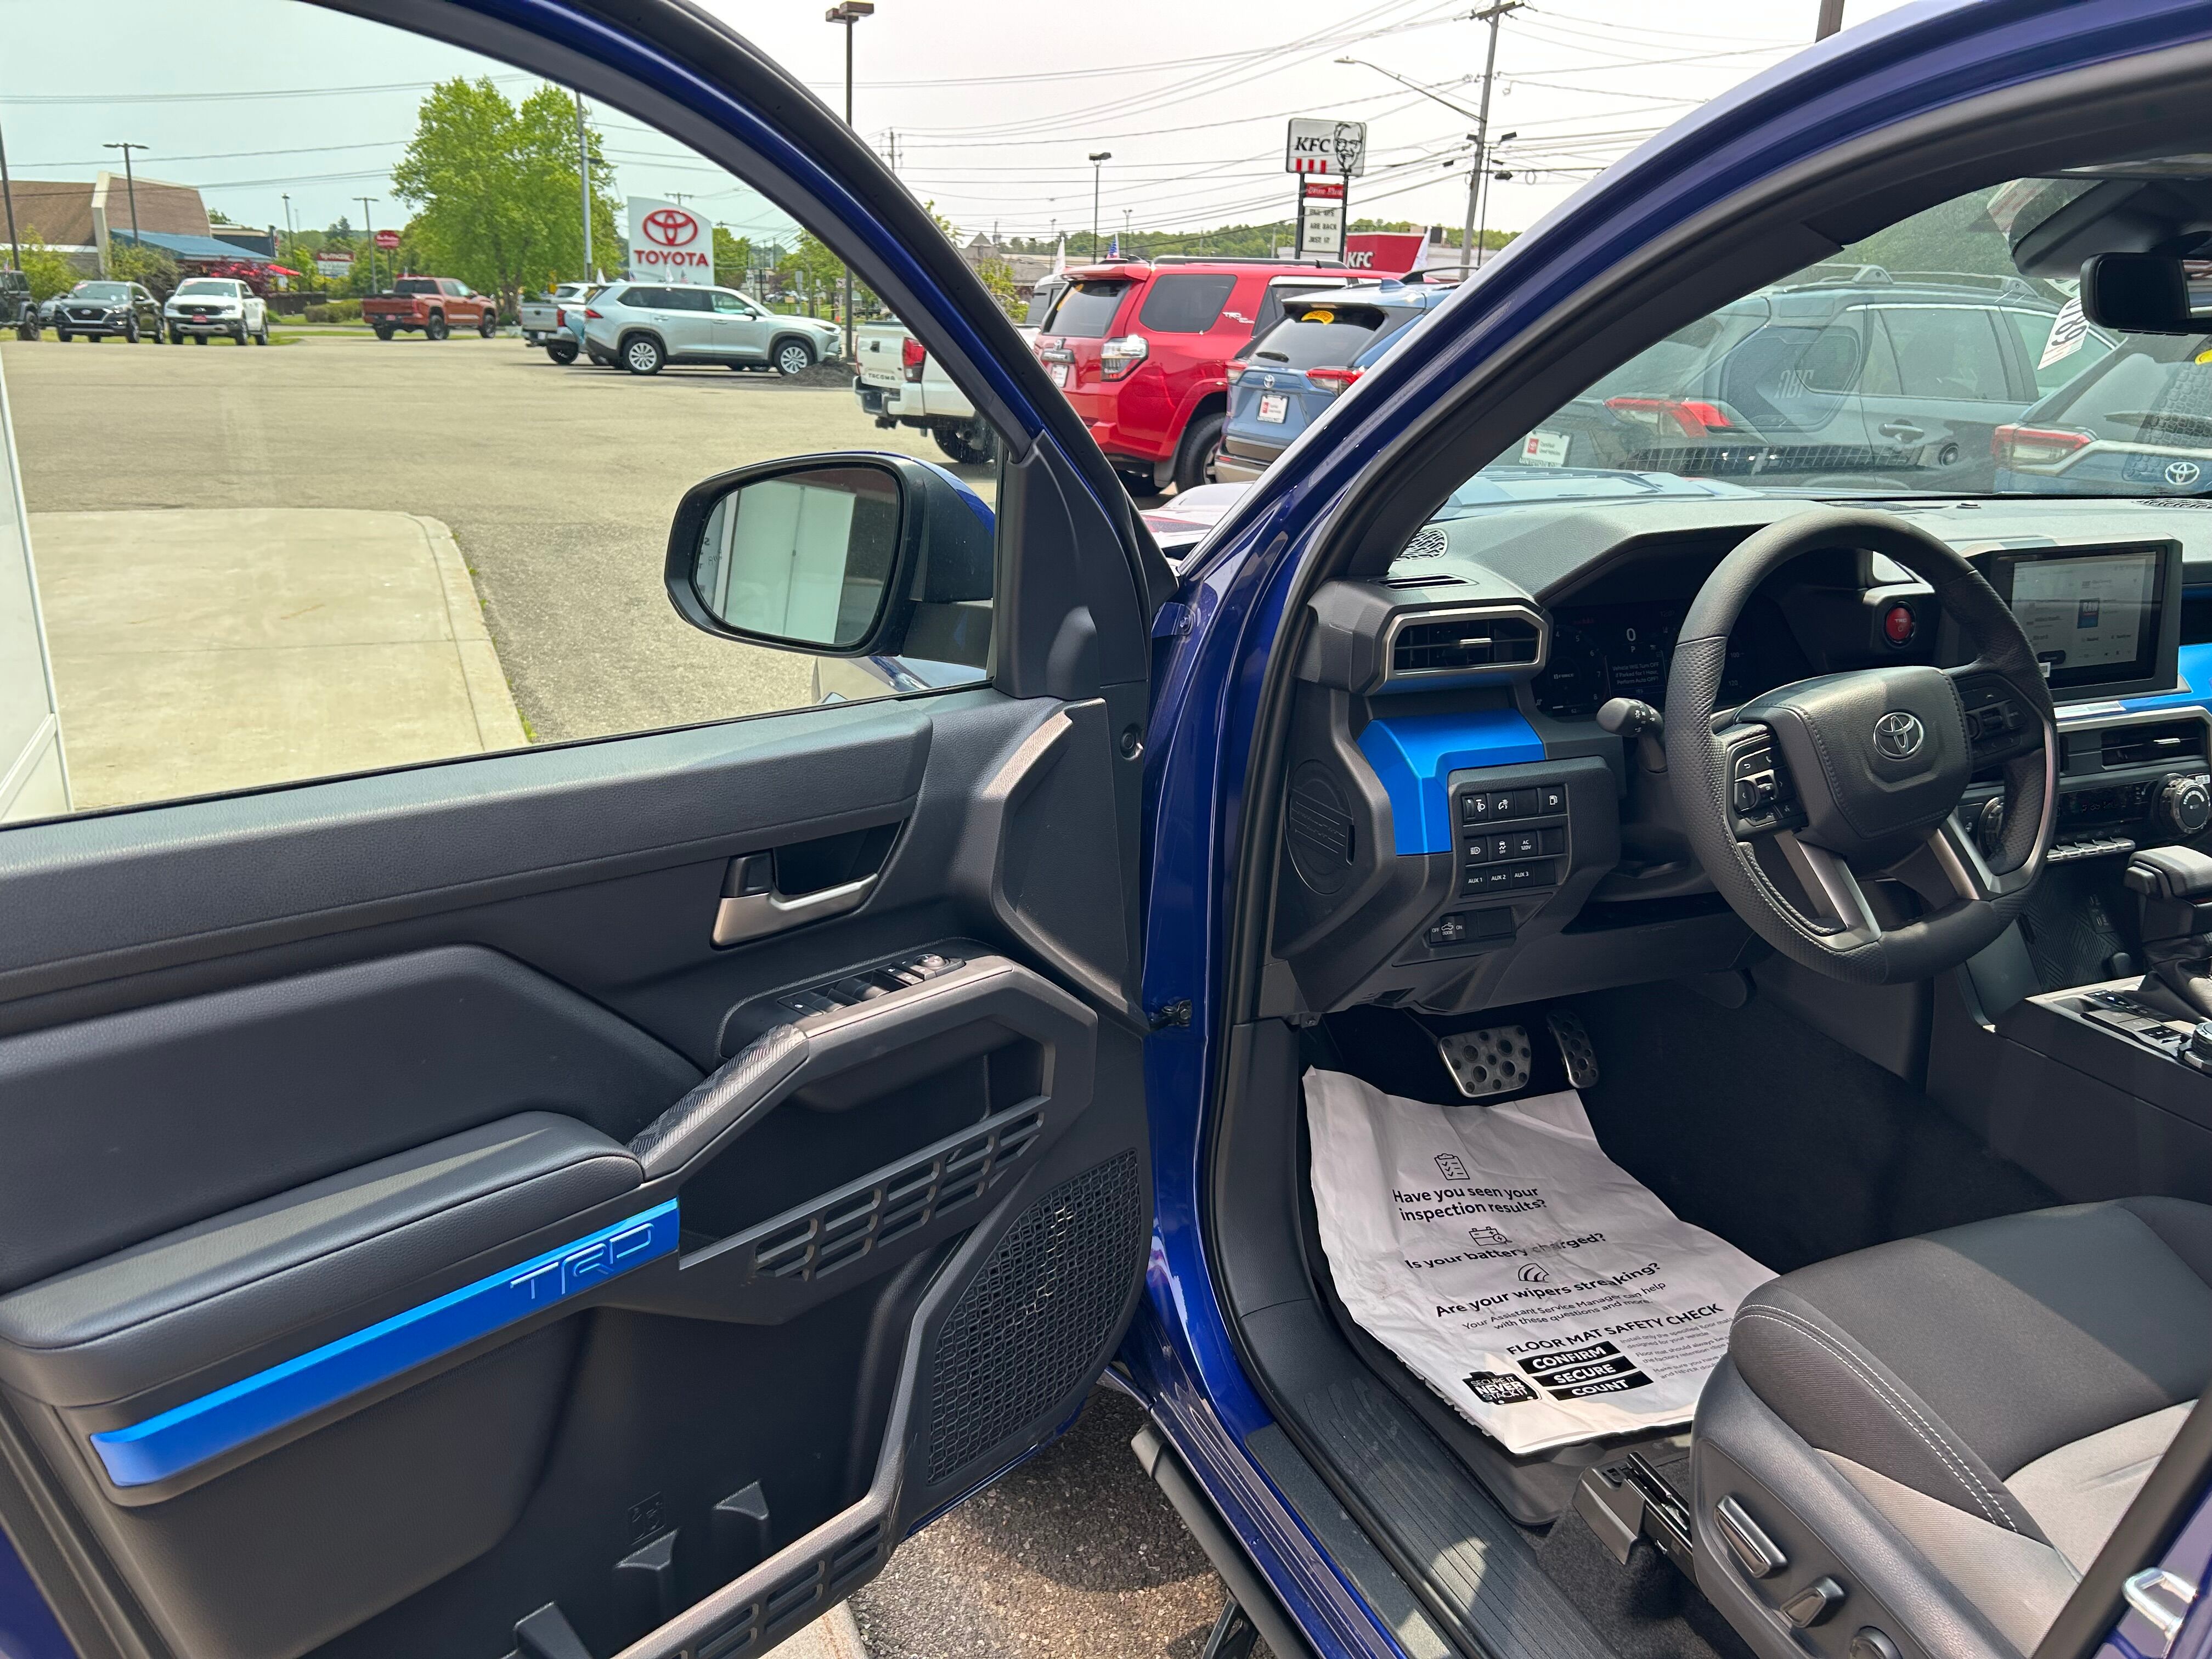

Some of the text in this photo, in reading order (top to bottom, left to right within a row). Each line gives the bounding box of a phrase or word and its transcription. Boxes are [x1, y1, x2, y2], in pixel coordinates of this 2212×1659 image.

[1294, 137, 1330, 153] KFC
[634, 250, 709, 267] TOYOTA
[1346, 251, 1373, 268] KFC
[1626, 628, 1636, 641] 0
[1392, 1187, 1538, 1204] Have you seen your
[1399, 1199, 1548, 1222] inspection results?
[1404, 1233, 1606, 1269] Is your battery charged?
[509, 1222, 654, 1300] TRD
[1436, 1262, 1661, 1317] Are your wipers streaking?
[1462, 1282, 1666, 1330] Your Assistant Service Manager can help
[1493, 1298, 1654, 1330] with these questions and more.
[1506, 1303, 1724, 1356] FLOOR MAT SAFETY CHECK
[1620, 1335, 1641, 1344] Install
[1669, 1326, 1699, 1336] specified
[1627, 1340, 1658, 1348] designed
[1668, 1344, 1692, 1352] should
[1692, 1339, 1714, 1347] always
[1532, 1346, 1606, 1369] CONFIRM
[1655, 1353, 1679, 1362] factory
[1680, 1347, 1709, 1357] retention
[1554, 1364, 1616, 1385] SECURE
[1700, 1362, 1718, 1370] doub
[1470, 1377, 1506, 1387] SECURE
[1475, 1381, 1524, 1395] NEVER
[1571, 1379, 1629, 1396] COUNT
[1483, 1387, 1528, 1400] STACK IT
